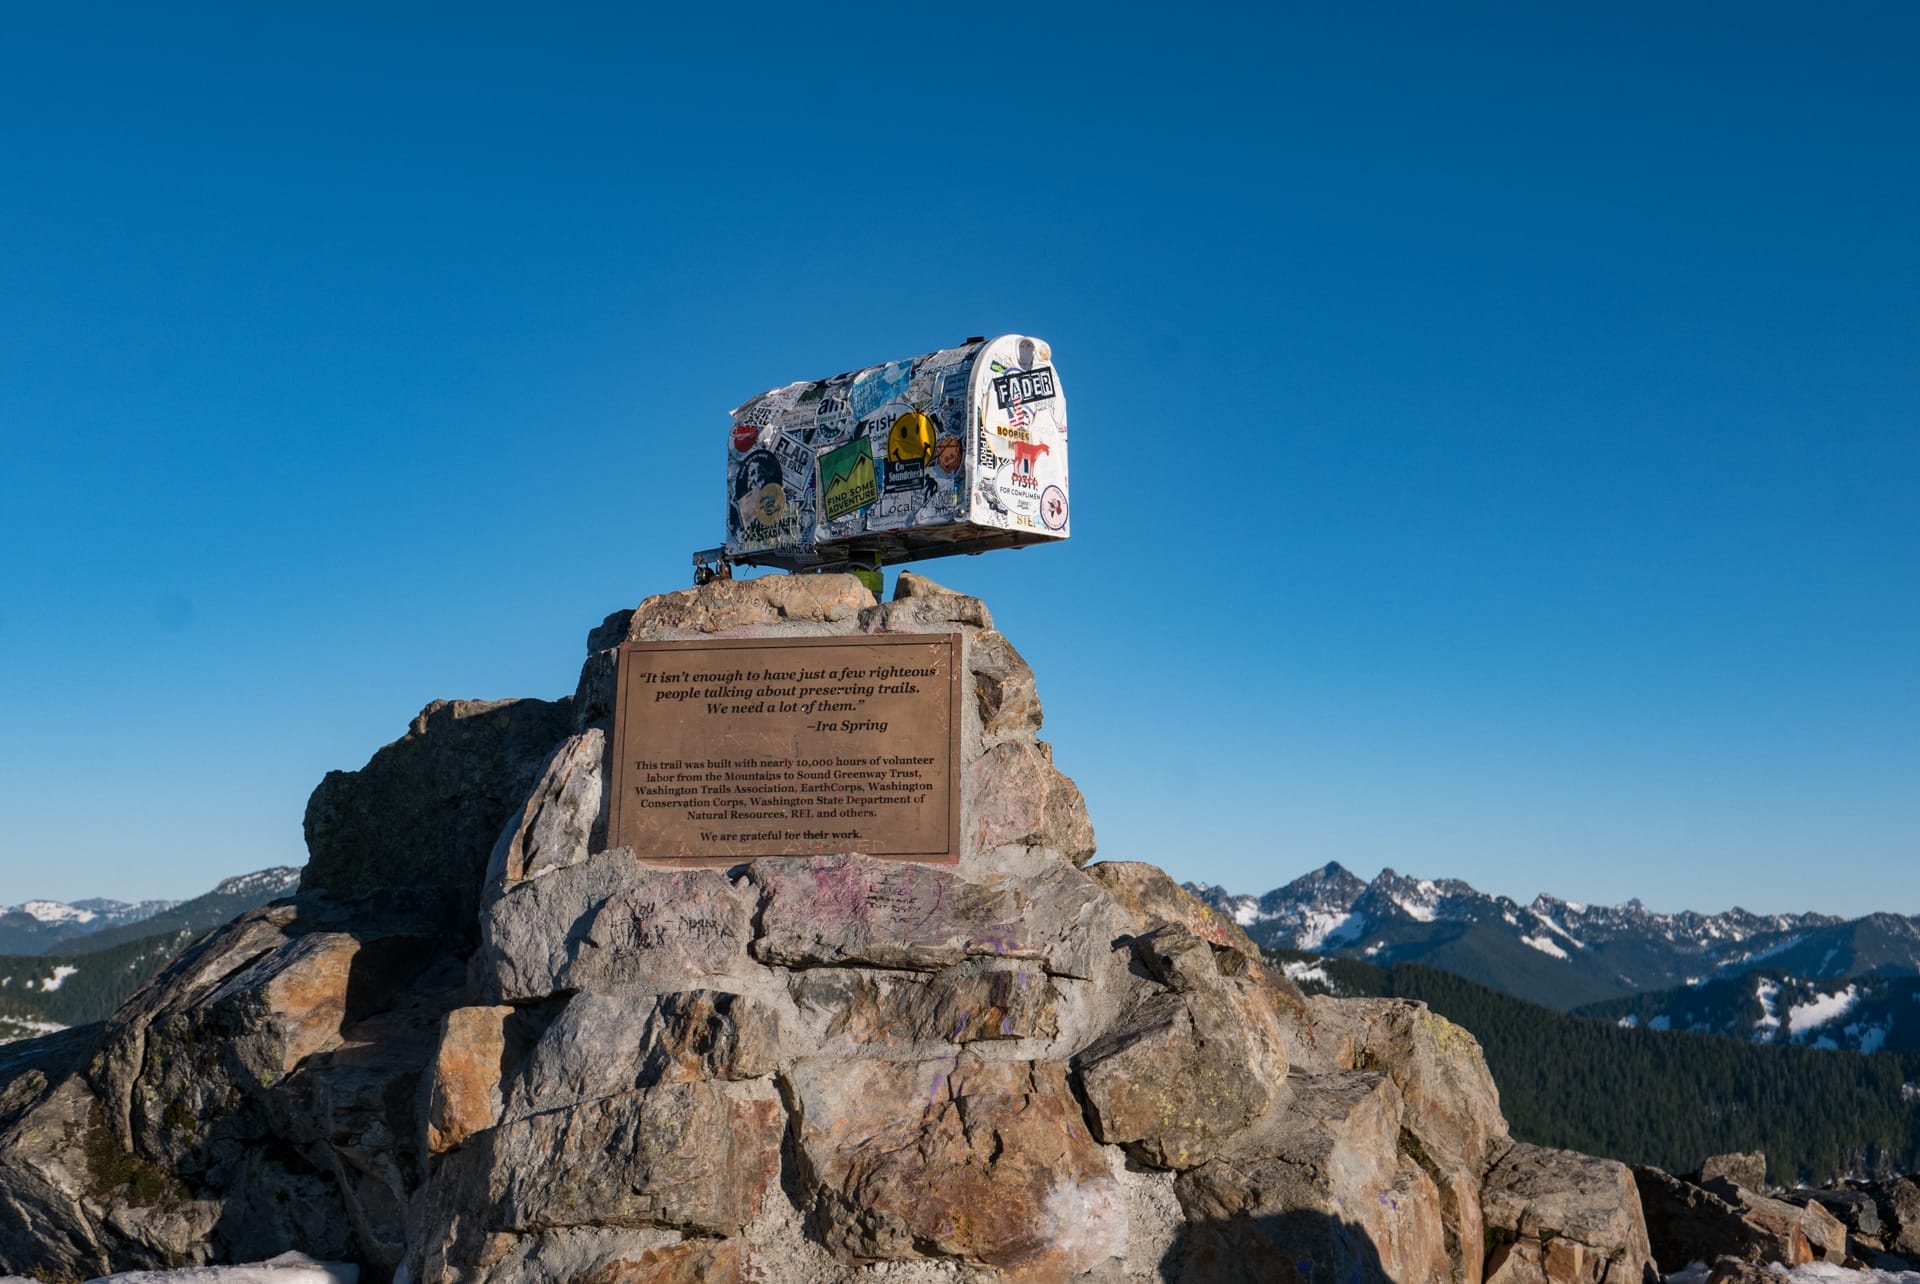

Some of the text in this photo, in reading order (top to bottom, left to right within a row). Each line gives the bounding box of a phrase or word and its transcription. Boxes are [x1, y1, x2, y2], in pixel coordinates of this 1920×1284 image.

[999, 370, 1054, 403] FADER
[868, 413, 897, 434] FISH
[775, 436, 809, 466] FLAG
[787, 457, 804, 476] FAIL
[888, 468, 924, 482] Soundcheck
[827, 480, 875, 506] FIND SOME
[828, 488, 876, 514] ADVENTURE
[880, 495, 914, 518] Local
[640, 666, 936, 684] “It isn’t enough to have just a few righteous
[655, 682, 920, 702] people talking about preserving trails.
[707, 700, 865, 715] We need a lot of them.”
[840, 719, 888, 734] Spring
[635, 760, 657, 770] This
[660, 760, 682, 769] trail
[707, 759, 731, 769] built
[734, 759, 757, 768] with
[759, 759, 793, 769] nearly
[796, 760, 833, 768] 10,000
[836, 757, 867, 766] hours
[869, 756, 882, 765] of
[882, 756, 935, 765] volunteer
[647, 769, 922, 782] labor from the Mountains to Sound Greenway Trust,
[635, 782, 933, 796] Washington Trails Association, EarthCorps, Washington
[640, 794, 926, 808] Conservation Corps, Washington State Department of
[687, 810, 728, 820] Natural
[730, 810, 788, 820] Resources,
[817, 808, 837, 818] and
[839, 808, 877, 818] others.
[700, 829, 863, 843] We are grateful for their work.
